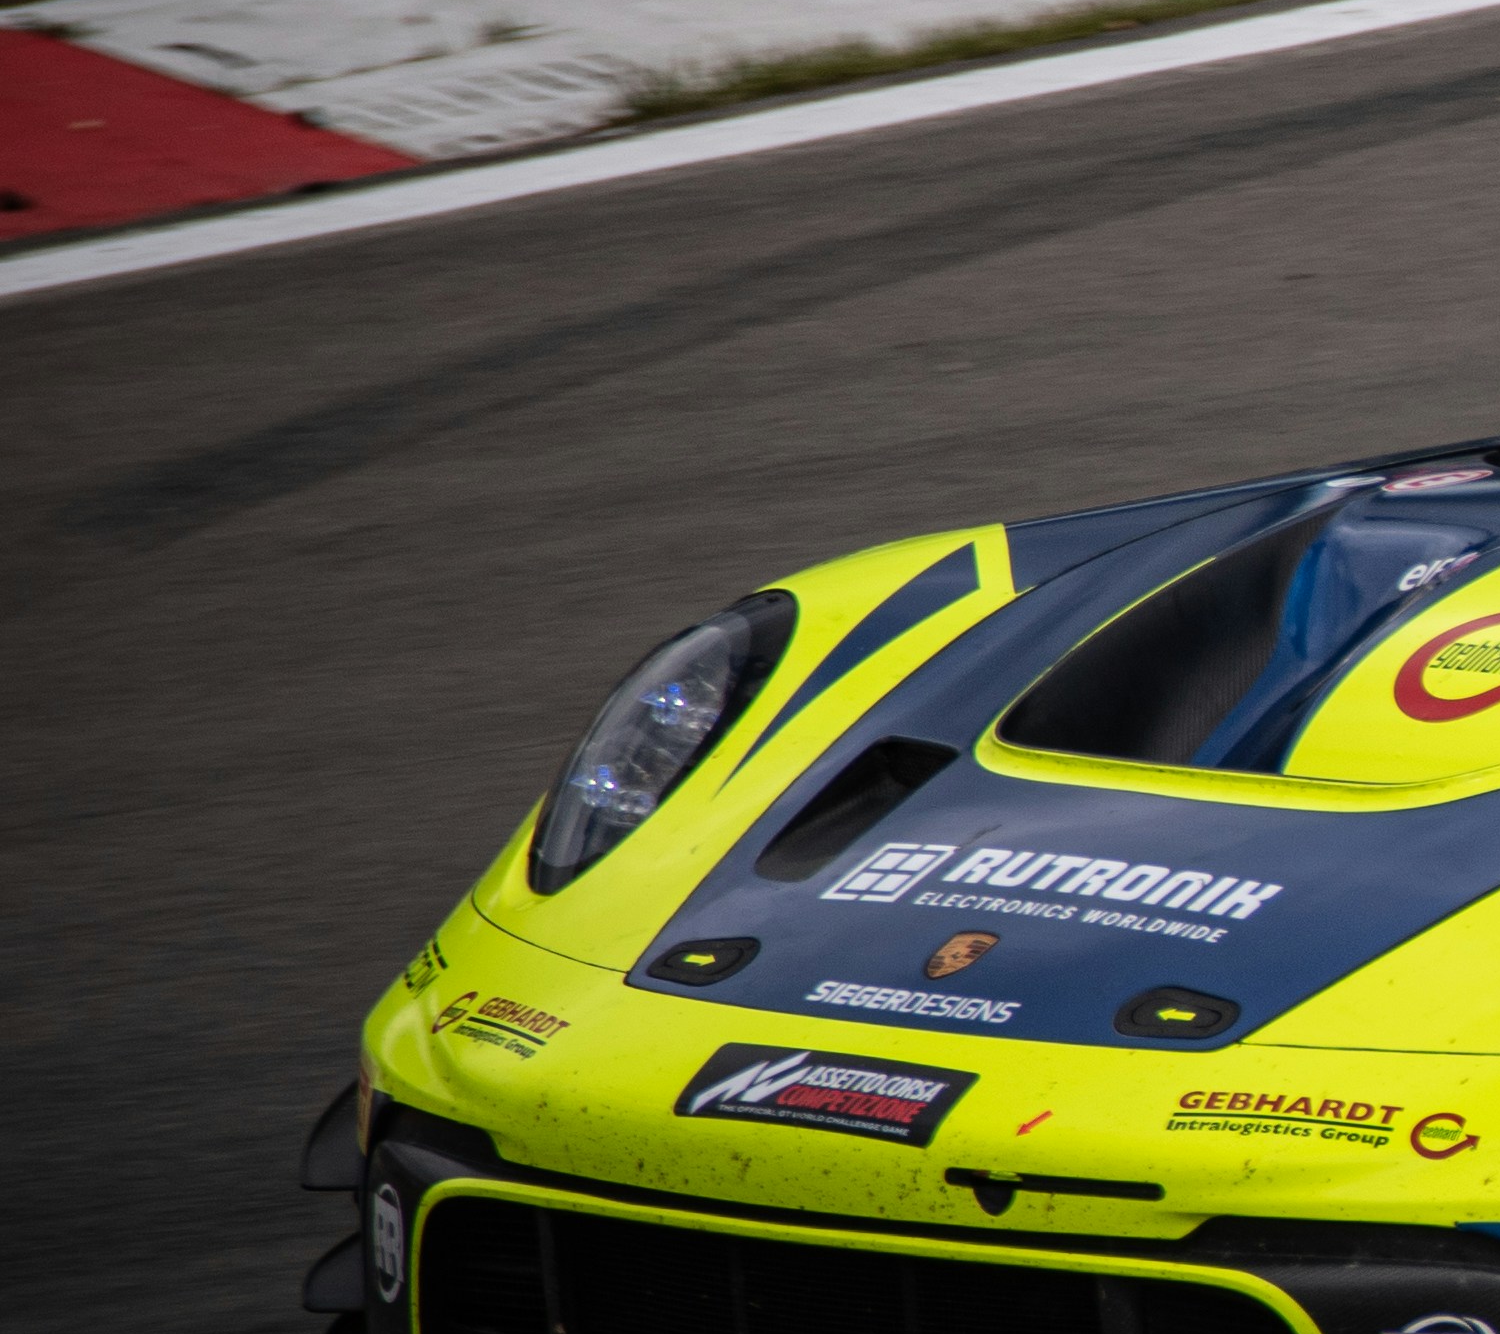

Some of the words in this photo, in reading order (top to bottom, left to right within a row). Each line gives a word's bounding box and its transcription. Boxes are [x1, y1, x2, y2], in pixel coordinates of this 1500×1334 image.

[942, 848, 1283, 919] RUTRONIK
[913, 892, 1076, 921] ELECTRONICS
[1081, 907, 1229, 944] WORLDWIDE
[478, 997, 571, 1039] GEBHARDT
[777, 1085, 928, 1124] COMPETIZIONE
[1179, 1091, 1404, 1125] GEBHARDT
[1166, 1119, 1312, 1137] Intralogistics
[1320, 1127, 1390, 1149] Group
